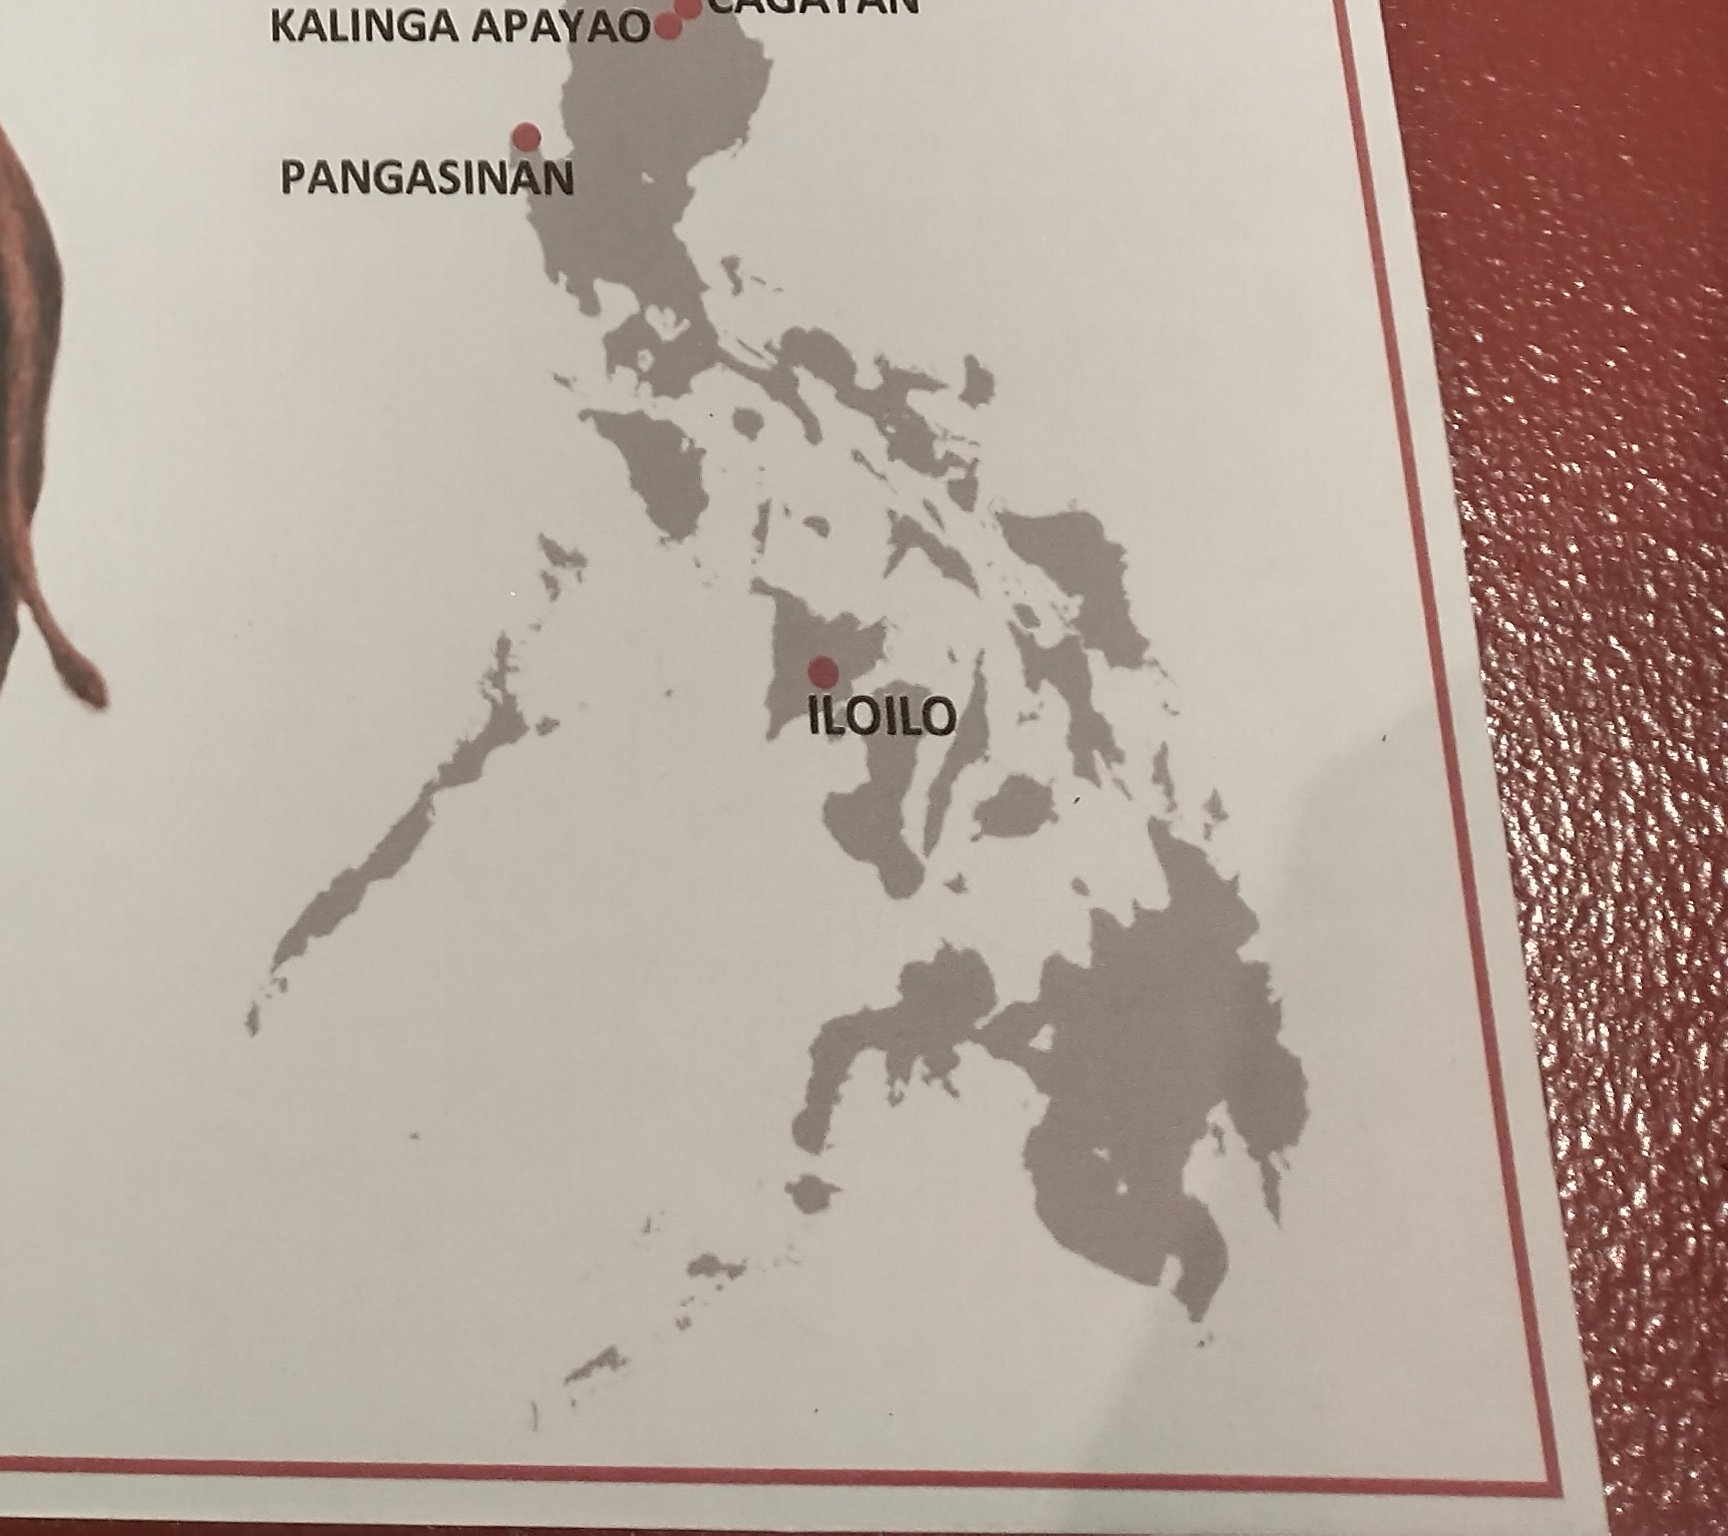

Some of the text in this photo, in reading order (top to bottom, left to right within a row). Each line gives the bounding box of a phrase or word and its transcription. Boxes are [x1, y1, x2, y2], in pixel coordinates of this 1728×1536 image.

[271, 8, 652, 44] KALINGA APAYAO
[282, 159, 575, 197] PANGASINAN
[807, 694, 958, 737] ILOILO
